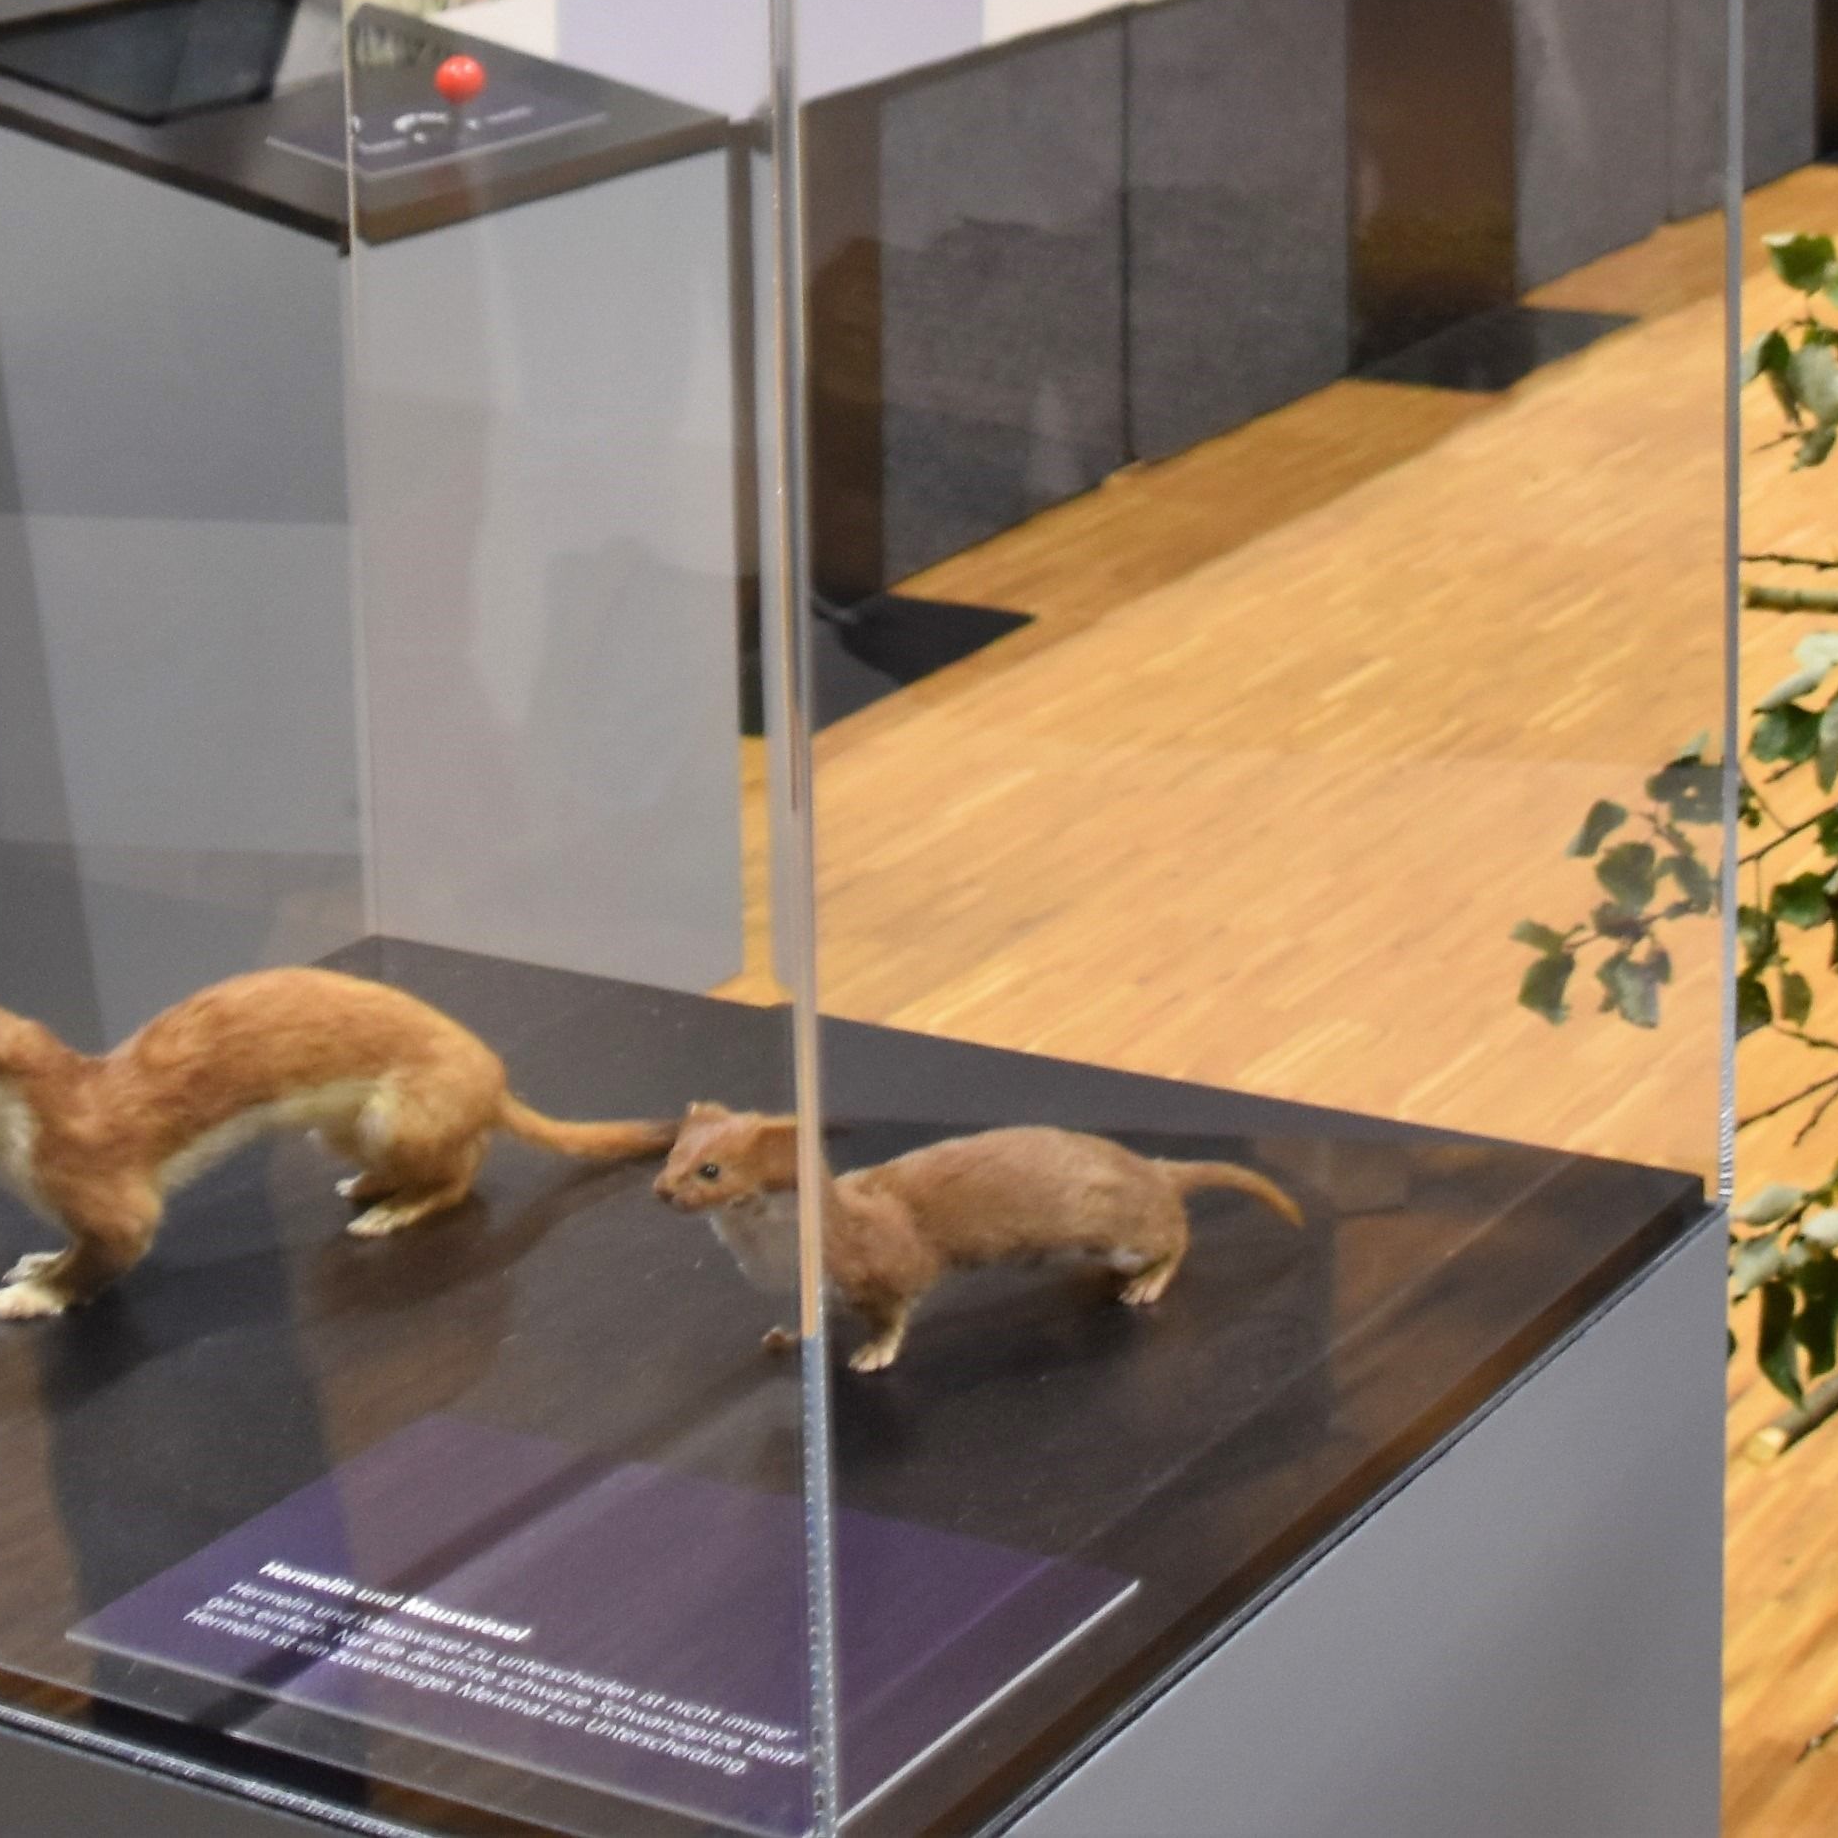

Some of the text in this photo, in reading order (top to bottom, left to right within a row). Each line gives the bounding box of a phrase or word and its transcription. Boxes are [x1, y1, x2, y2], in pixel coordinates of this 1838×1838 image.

[182, 1607, 271, 1642] Hermelin
[269, 1633, 299, 1651] ist
[296, 1641, 330, 1658] ein
[328, 1648, 457, 1693] zuverlässiges
[455, 1681, 551, 1718] Merkmal
[545, 1710, 585, 1727] zur
[226, 1580, 314, 1613] Hermelin
[313, 1606, 360, 1625] und
[356, 1614, 472, 1655] Mauswiesel
[465, 1647, 497, 1663] zu
[496, 1654, 636, 1701] unterscheiden
[637, 1690, 666, 1709] ist
[665, 1700, 722, 1724] nicht
[258, 1560, 533, 1643] Hermelin und Mauswiesel
[203, 1596, 257, 1619] ganz
[332, 1628, 374, 1649] Nur
[371, 1639, 407, 1659] die
[496, 1674, 593, 1710] schwarze
[592, 1698, 743, 1752] Schwanzspitze
